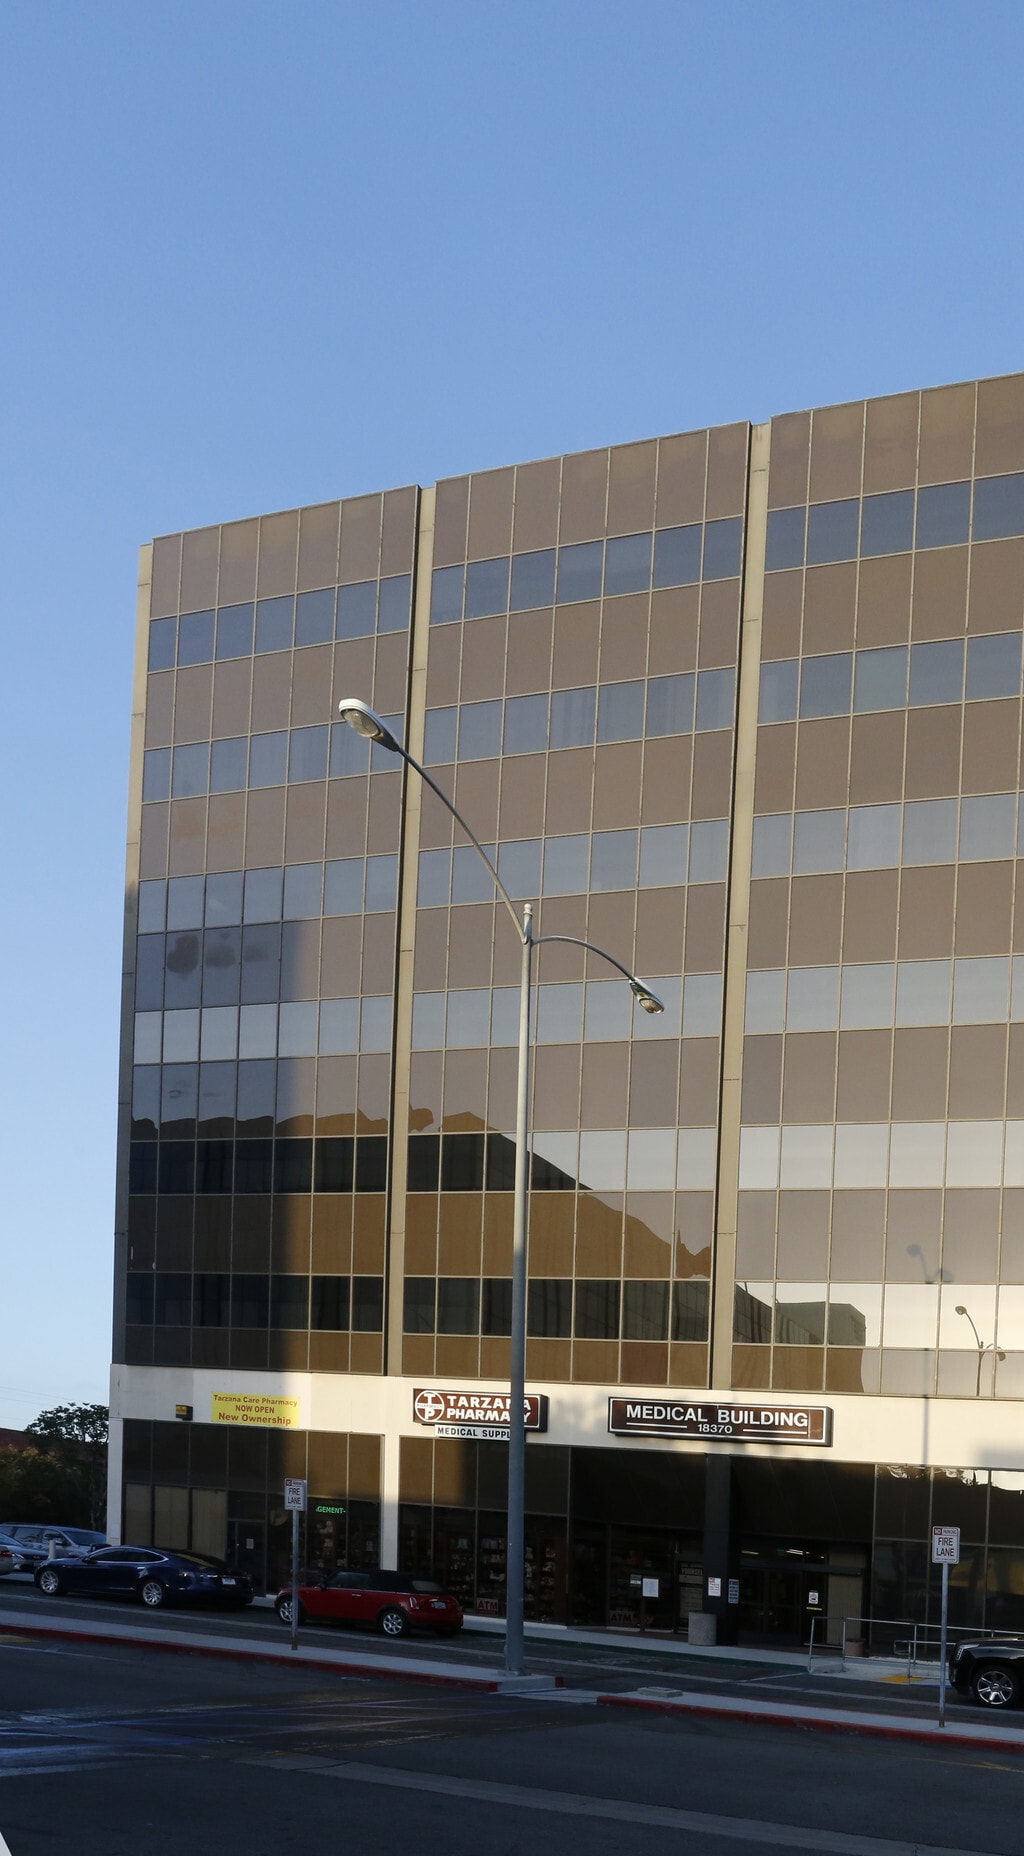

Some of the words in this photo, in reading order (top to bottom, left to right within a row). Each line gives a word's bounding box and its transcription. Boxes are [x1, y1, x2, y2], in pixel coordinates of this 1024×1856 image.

[213, 1395, 241, 1403] Tarzana
[243, 1396, 260, 1404] Care
[262, 1398, 298, 1408] Pharmacy
[447, 1396, 532, 1411] TARZAA
[235, 1405, 252, 1413] NOW
[255, 1406, 275, 1414] OPEN
[218, 1412, 239, 1421] New
[242, 1414, 291, 1426] Ownership
[446, 1408, 532, 1424] PHARMAY
[626, 1404, 708, 1422] MEDICAL
[717, 1409, 808, 1427] BUILDING
[437, 1427, 478, 1437] MEDICAL
[482, 1430, 511, 1439] SUPPL
[697, 1424, 733, 1434] 18370
[289, 1488, 300, 1496] FIRE
[288, 1496, 301, 1504] LANE
[938, 1537, 953, 1546] FIRE
[936, 1548, 954, 1556] LANE
[478, 1600, 498, 1611] ATM
[611, 1613, 632, 1623] ATM
